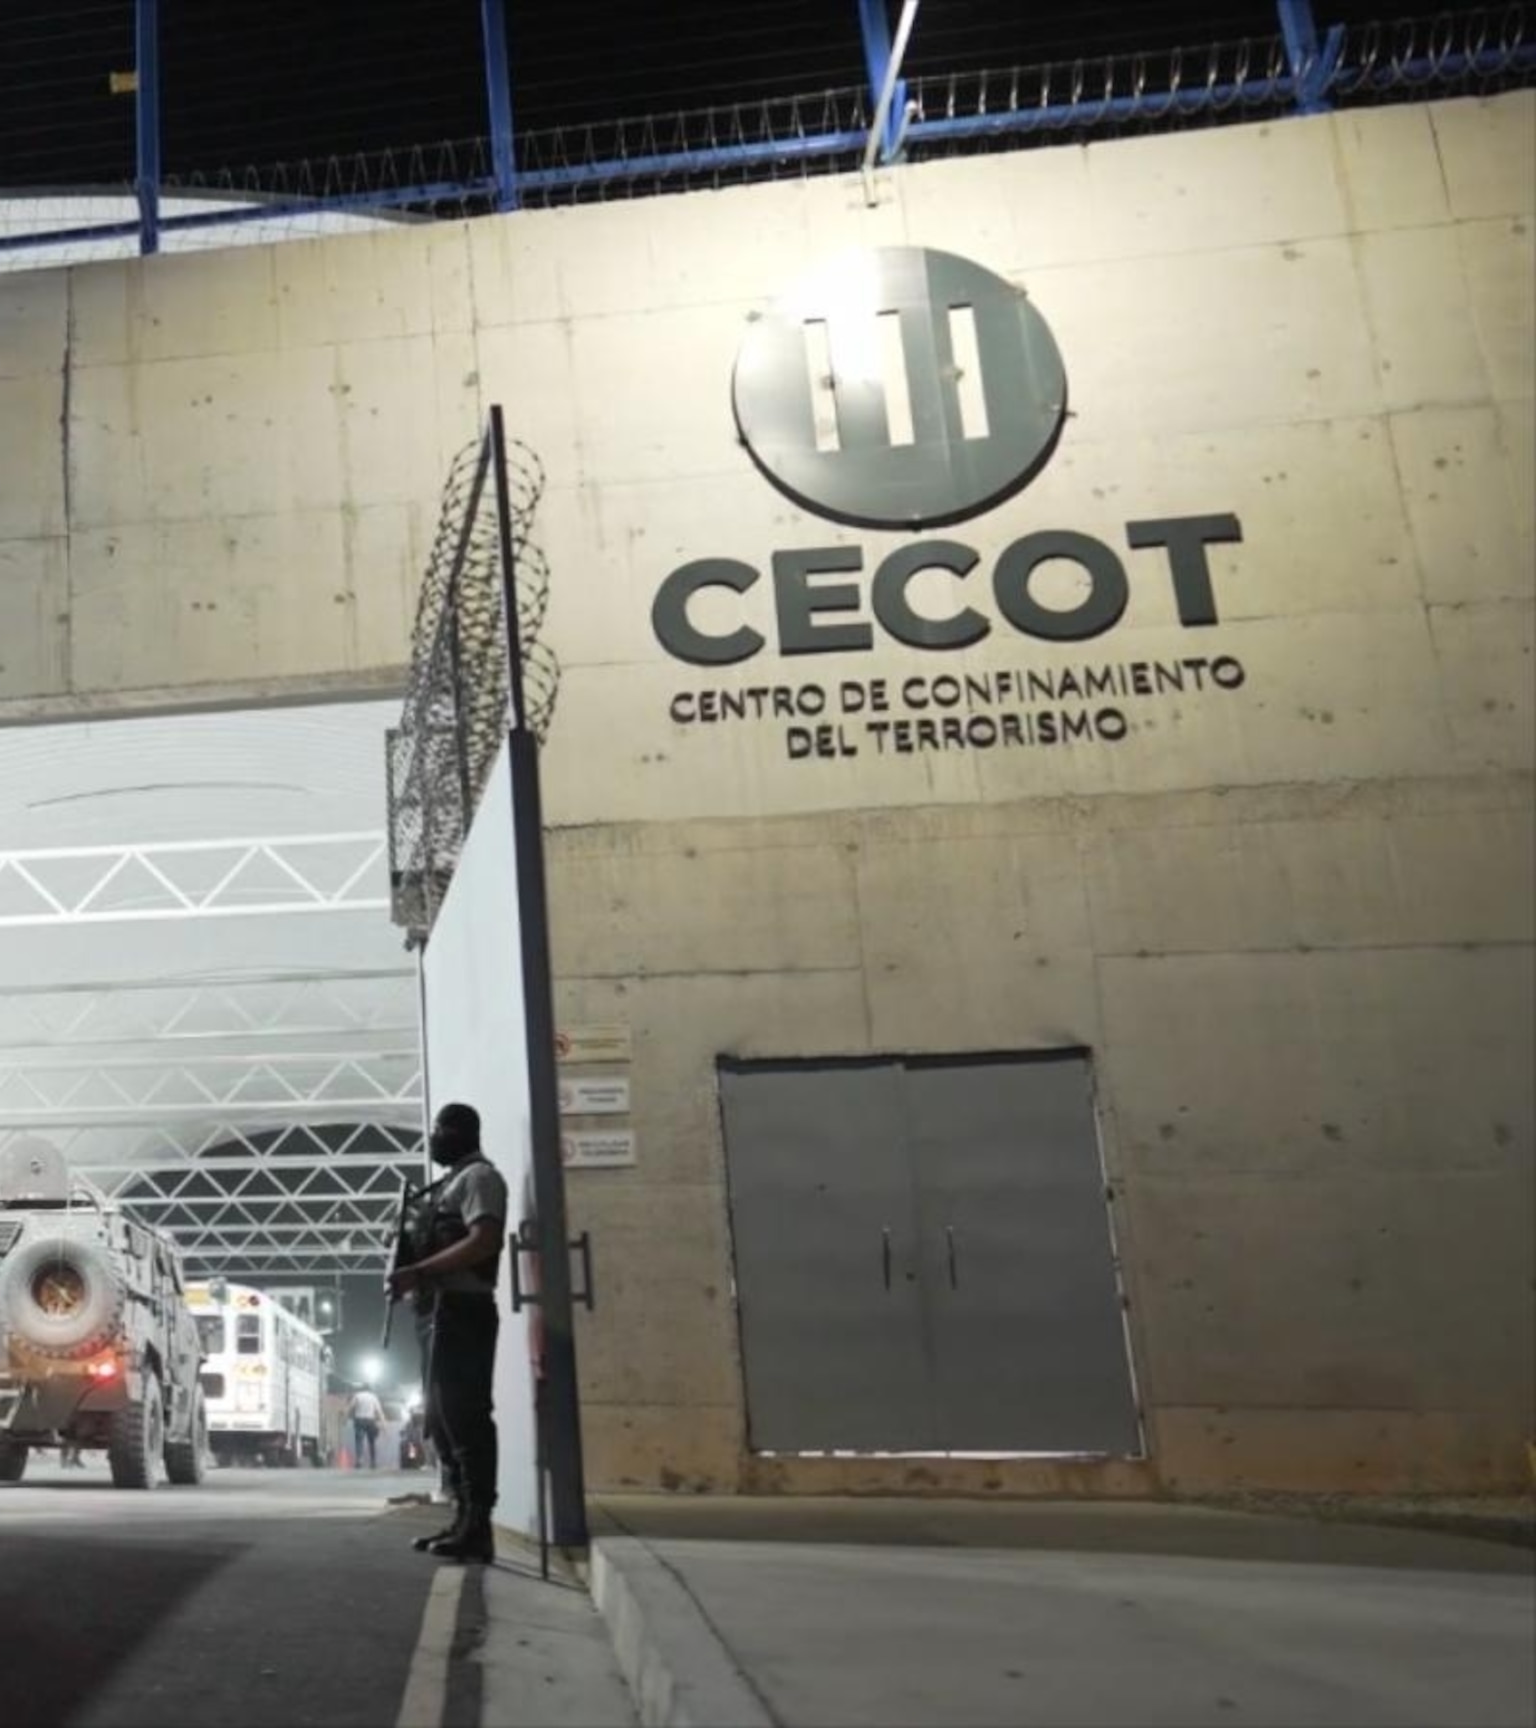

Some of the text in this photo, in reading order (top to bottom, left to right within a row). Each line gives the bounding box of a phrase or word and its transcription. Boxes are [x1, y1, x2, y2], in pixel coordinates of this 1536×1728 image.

[651, 513, 1243, 667] CECOT
[669, 655, 1246, 724] CENTRO DE CONFINAMIENTO
[786, 707, 1128, 759] DEL TERRORISMO
